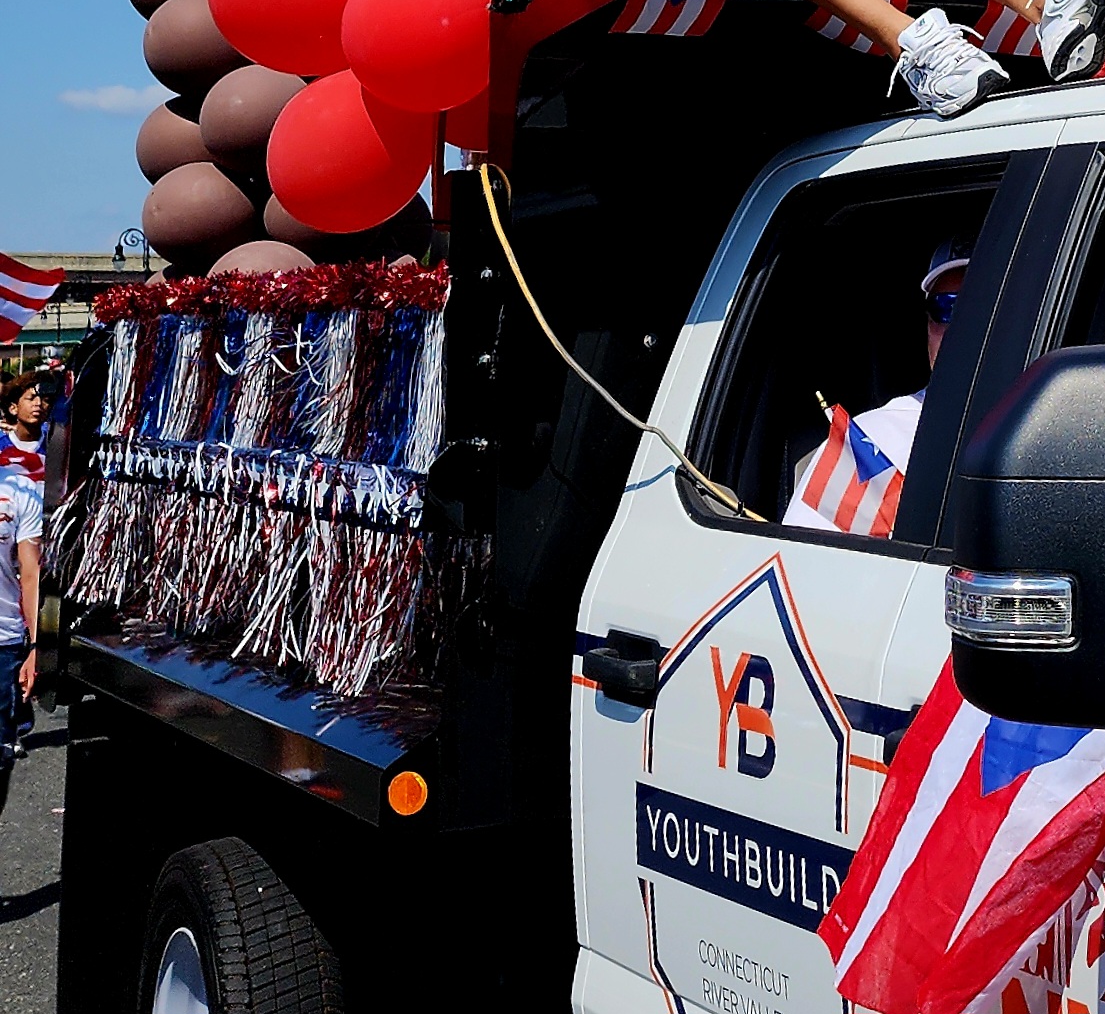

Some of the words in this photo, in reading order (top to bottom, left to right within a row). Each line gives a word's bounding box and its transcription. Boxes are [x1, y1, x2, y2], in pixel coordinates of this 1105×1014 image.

[710, 646, 776, 779] YB
[646, 804, 841, 914] YOUTHBUILD
[698, 939, 790, 1001] CONNECTICUT
[702, 977, 739, 1014] RIVER
